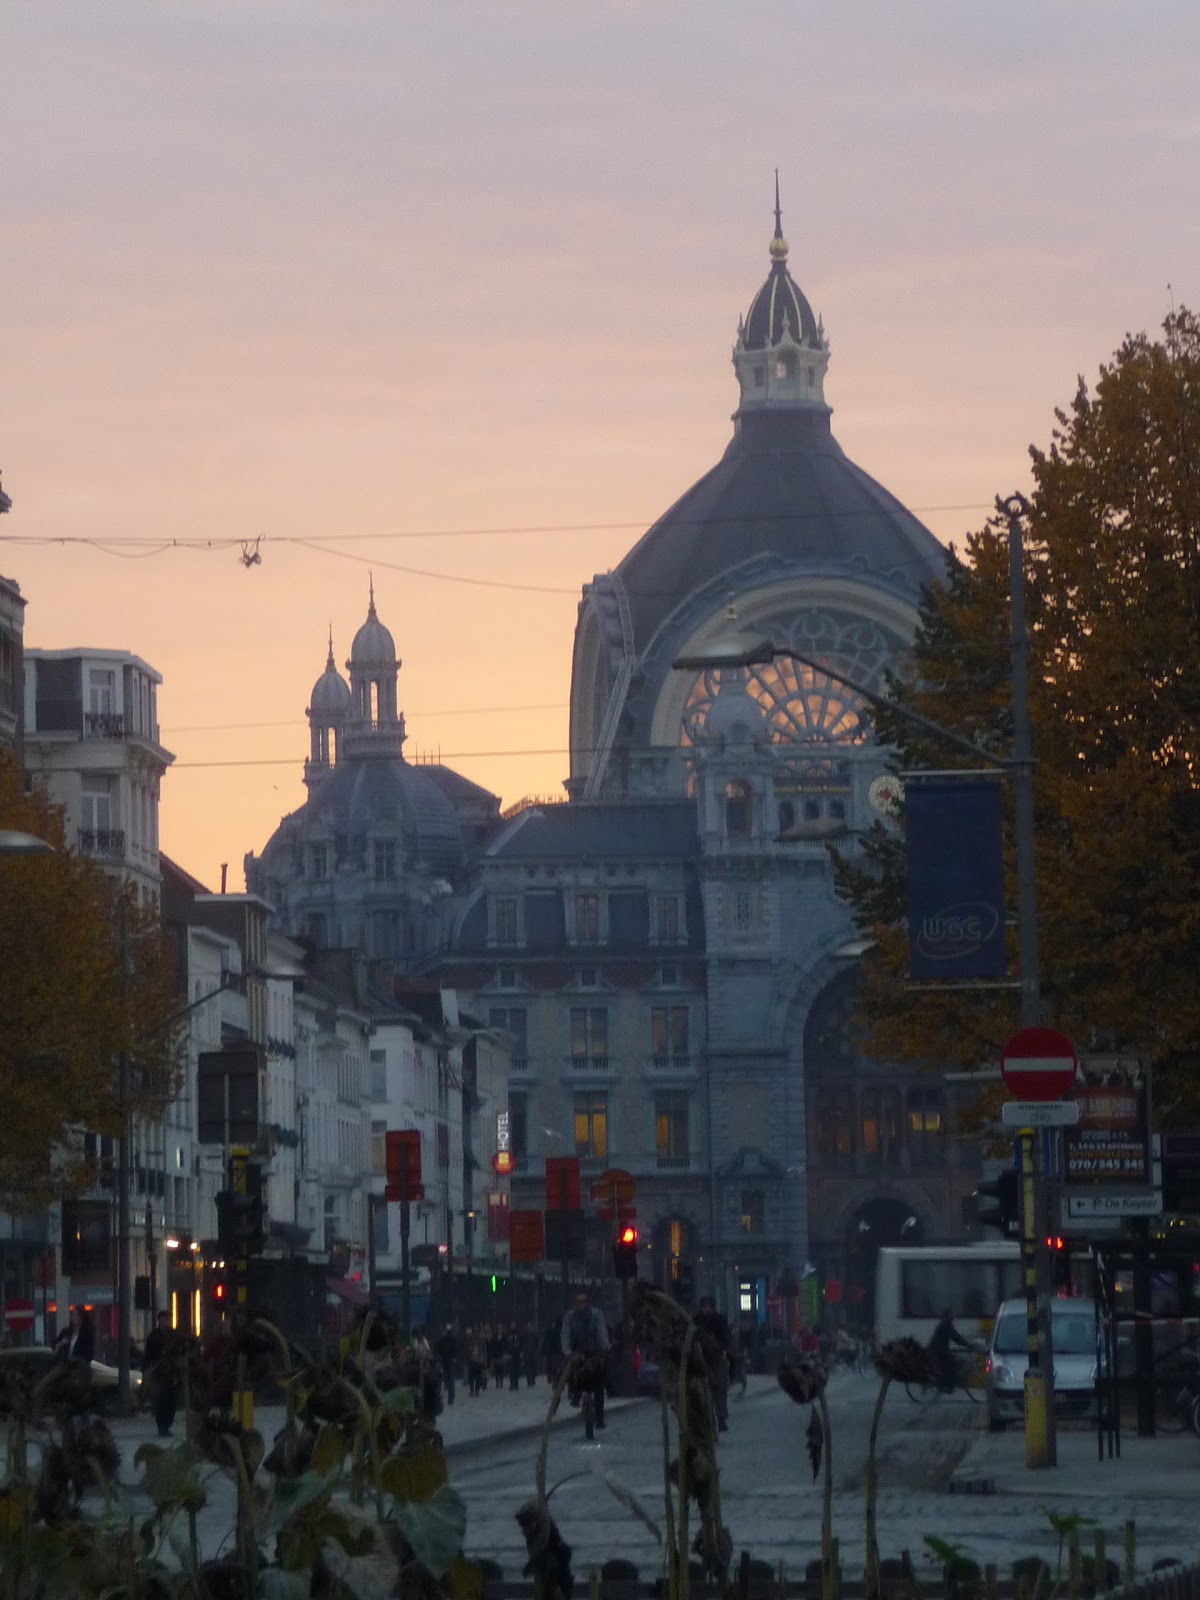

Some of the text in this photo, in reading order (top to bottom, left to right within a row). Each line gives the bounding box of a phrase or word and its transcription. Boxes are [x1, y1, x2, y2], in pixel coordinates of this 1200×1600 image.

[922, 914, 983, 944] UGC
[497, 1110, 509, 1149] HOTEL
[1105, 1199, 1120, 1208] De
[1122, 1199, 1157, 1209] Keyser
